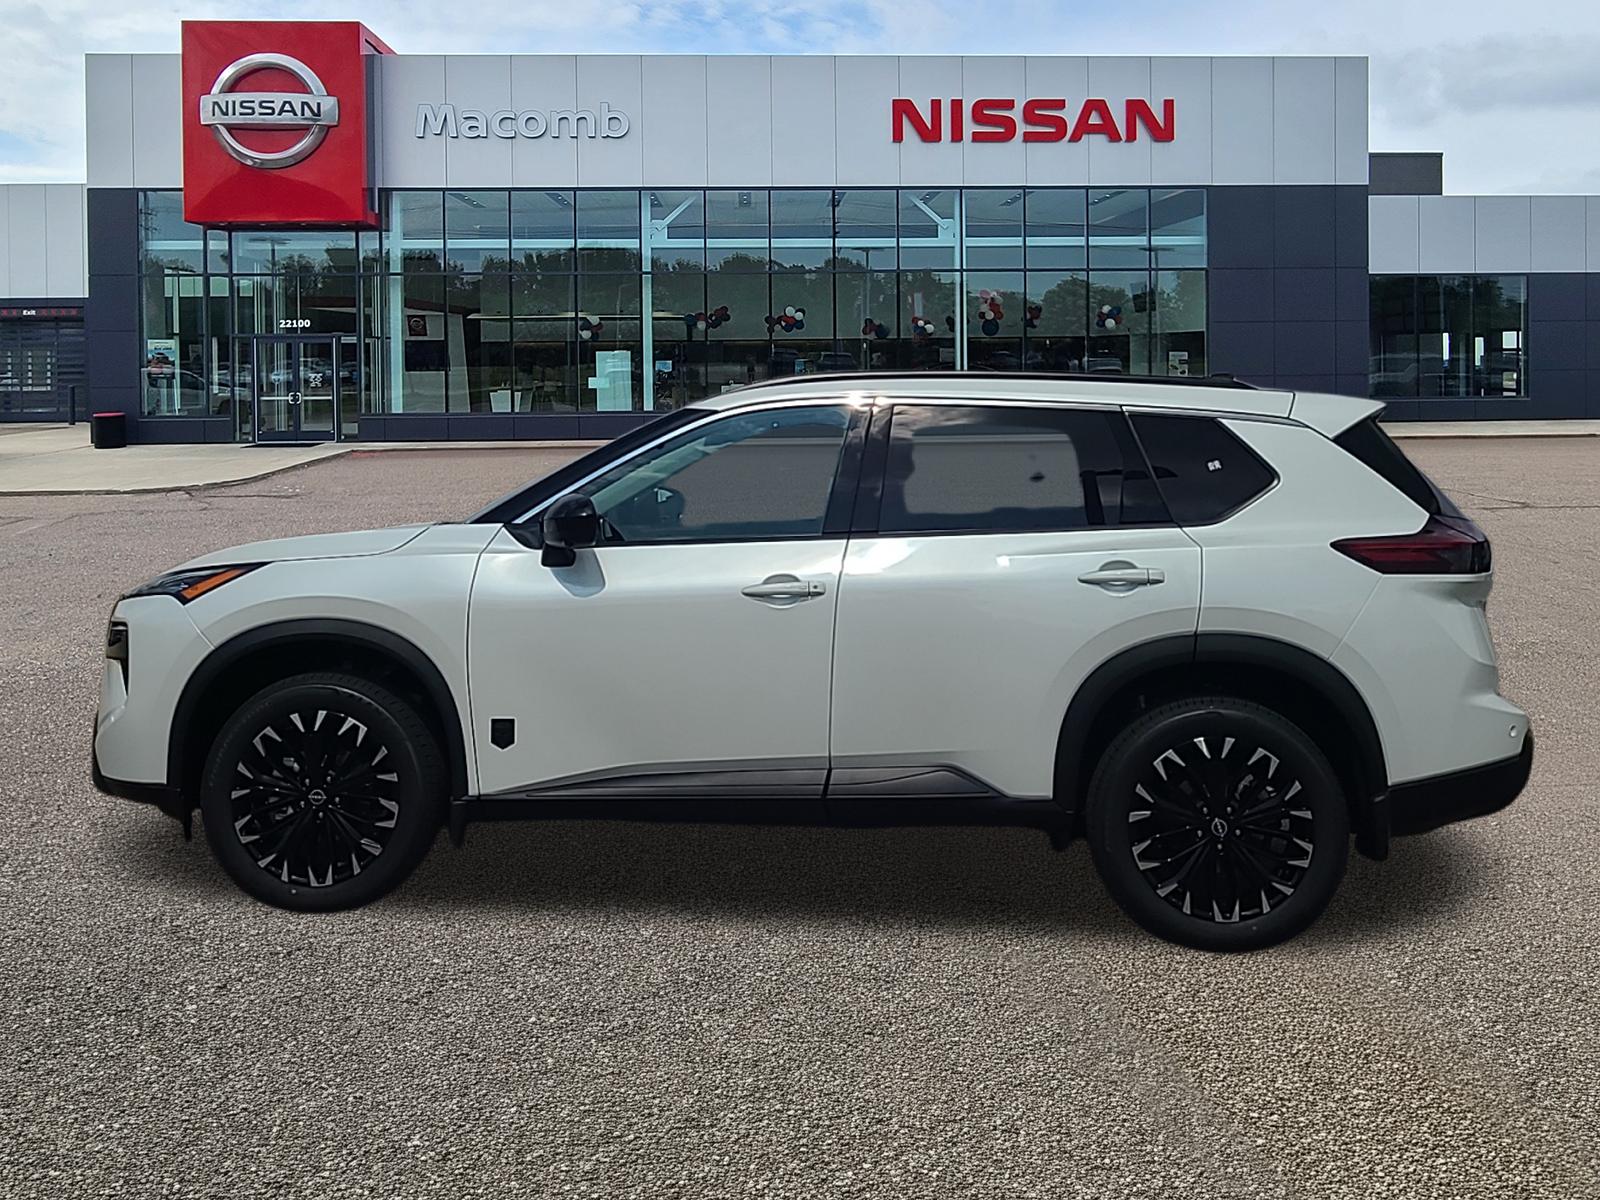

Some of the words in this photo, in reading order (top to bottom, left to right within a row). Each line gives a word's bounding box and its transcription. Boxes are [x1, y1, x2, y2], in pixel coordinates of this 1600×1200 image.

[211, 100, 321, 117] NISSAN
[415, 102, 629, 139] Macomb
[892, 98, 1174, 142] NISSAN
[279, 319, 311, 328] 22100
